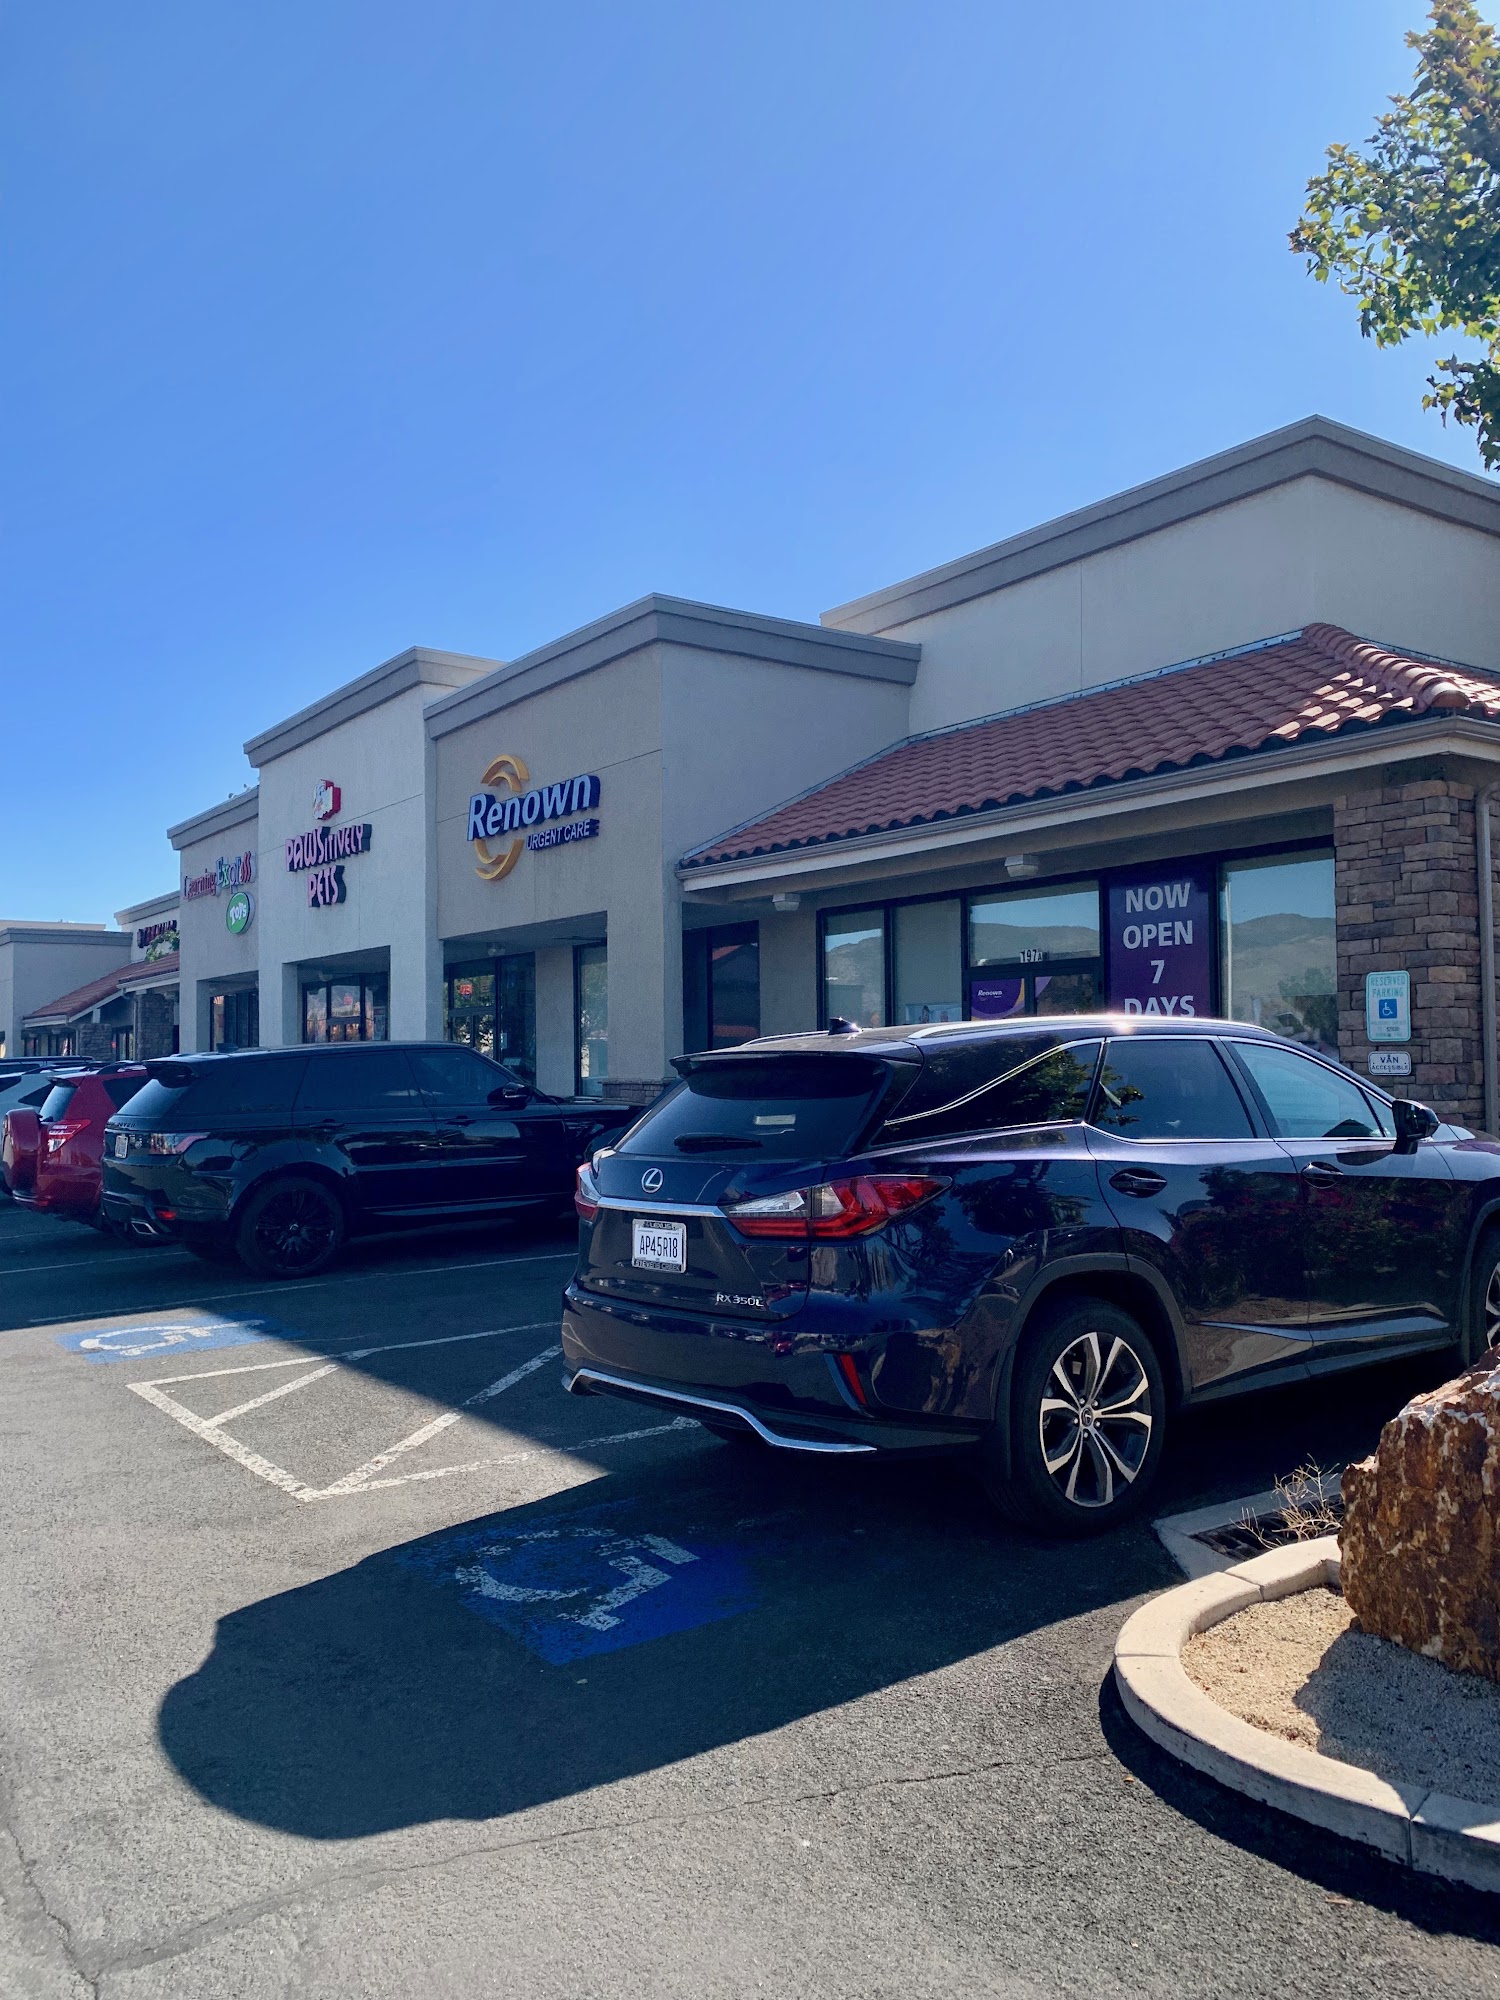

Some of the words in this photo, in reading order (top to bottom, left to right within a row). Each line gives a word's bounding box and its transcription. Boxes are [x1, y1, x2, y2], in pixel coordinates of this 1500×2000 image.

[467, 774, 597, 841] Renown
[526, 827, 563, 851] URGENT
[563, 818, 594, 841] CARE
[285, 824, 368, 872] PAWSITIVELY
[215, 851, 252, 895] Express
[307, 865, 343, 907] PETS
[1125, 882, 1191, 913] NOW
[1122, 920, 1194, 950] OPEN
[1150, 959, 1165, 984] 7
[1370, 975, 1405, 986] RESERVED
[978, 989, 1003, 997] Renown
[1372, 987, 1404, 997] PARKING
[1124, 995, 1195, 1018] DAYS
[1380, 1056, 1399, 1064] VAN
[639, 1235, 678, 1258] AP45R18
[716, 1294, 731, 1303] RX
[732, 1295, 764, 1307] 350L
